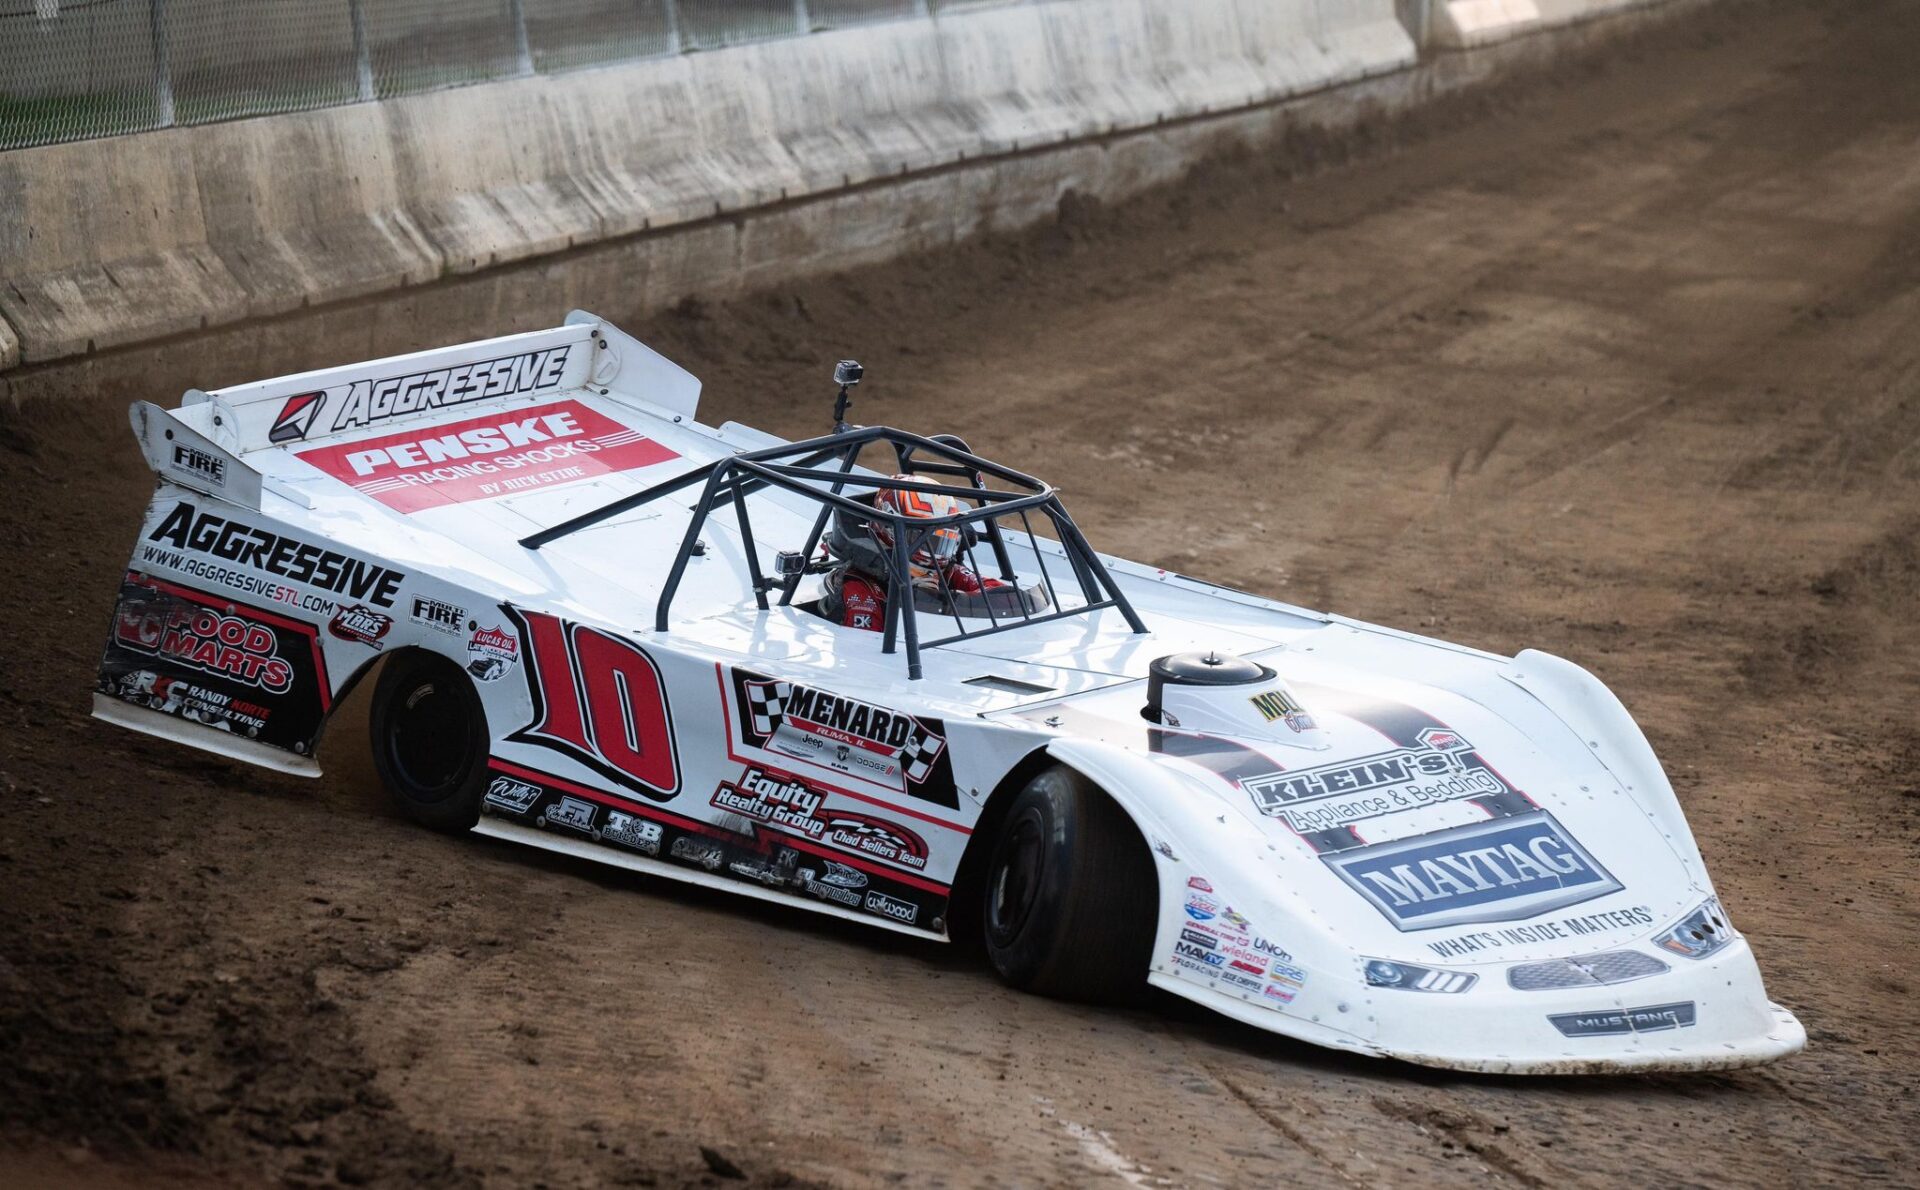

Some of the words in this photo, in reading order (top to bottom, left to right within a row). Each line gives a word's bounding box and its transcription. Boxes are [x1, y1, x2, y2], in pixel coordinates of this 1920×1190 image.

[331, 345, 572, 431] AGGRESSIVE
[174, 446, 223, 474] FIRE
[345, 412, 584, 476] PENSKE
[398, 461, 497, 487] RACING
[496, 439, 600, 469] SHOCKS
[148, 500, 405, 609] AGGRESSIVE
[142, 546, 334, 617] WWW.AGGRESSIVESTL.COM
[337, 609, 384, 632] MARS
[412, 598, 465, 625] FIRE
[428, 599, 465, 614] MULTI
[169, 603, 273, 653] FOOD
[476, 632, 501, 646] LUCAS
[501, 638, 513, 649] OIL
[161, 629, 289, 686] MARTS
[184, 697, 266, 728] CONSULTING
[188, 686, 232, 704] RANDY
[230, 699, 272, 720] KORTE
[512, 607, 680, 799] 10
[786, 684, 911, 748] MENARD
[802, 734, 824, 749] Jeep
[855, 739, 866, 748] IL
[856, 757, 886, 771] DODGE
[1257, 753, 1452, 804] KLEIN'S
[716, 787, 773, 819] Realty
[772, 806, 825, 836] Group
[743, 769, 821, 818] Equity
[1290, 794, 1388, 829] Appliance
[1387, 789, 1406, 806] &
[1410, 773, 1497, 803] Bedding
[604, 827, 657, 850] BUILDER
[609, 811, 662, 841] T&B
[833, 828, 859, 846] Chad
[861, 837, 897, 857] Sellers
[899, 848, 925, 868] Team
[1361, 835, 1583, 906] MAYTAG
[1175, 941, 1226, 965] MAVTV
[1221, 944, 1269, 967] wieland
[1426, 929, 1502, 958] WHAT'S
[1499, 918, 1568, 945] INSIDE
[1576, 1010, 1677, 1028] MUSTANG
